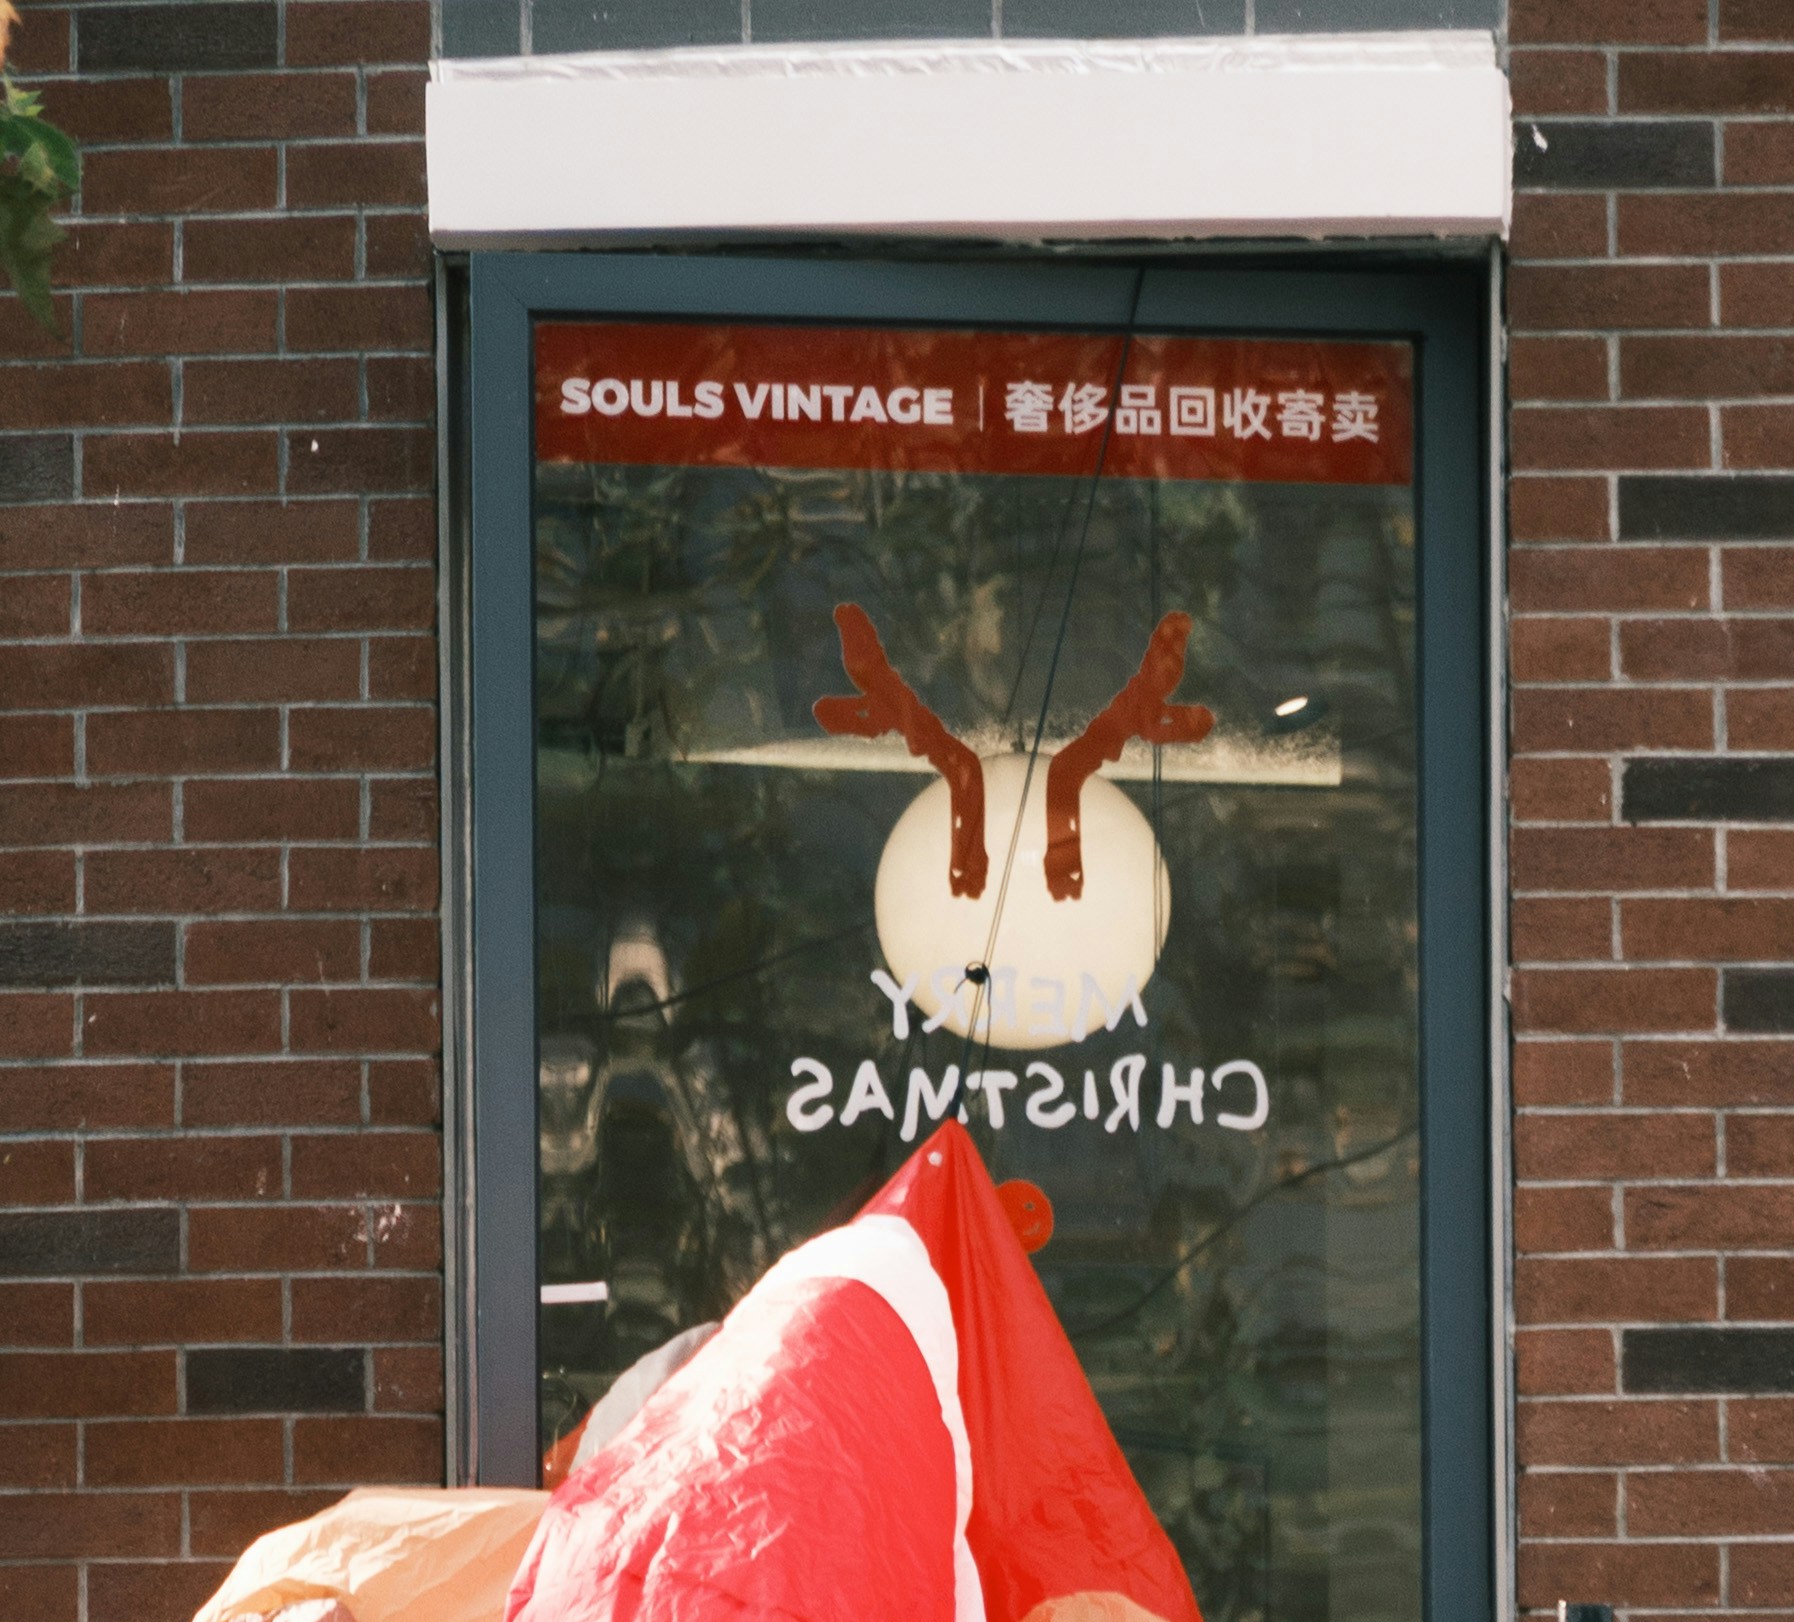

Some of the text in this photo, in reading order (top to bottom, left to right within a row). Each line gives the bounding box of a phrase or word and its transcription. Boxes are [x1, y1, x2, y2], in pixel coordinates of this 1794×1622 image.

[560, 378, 1382, 446] SOULS VINTAGE 奢侈品回收寄卖
